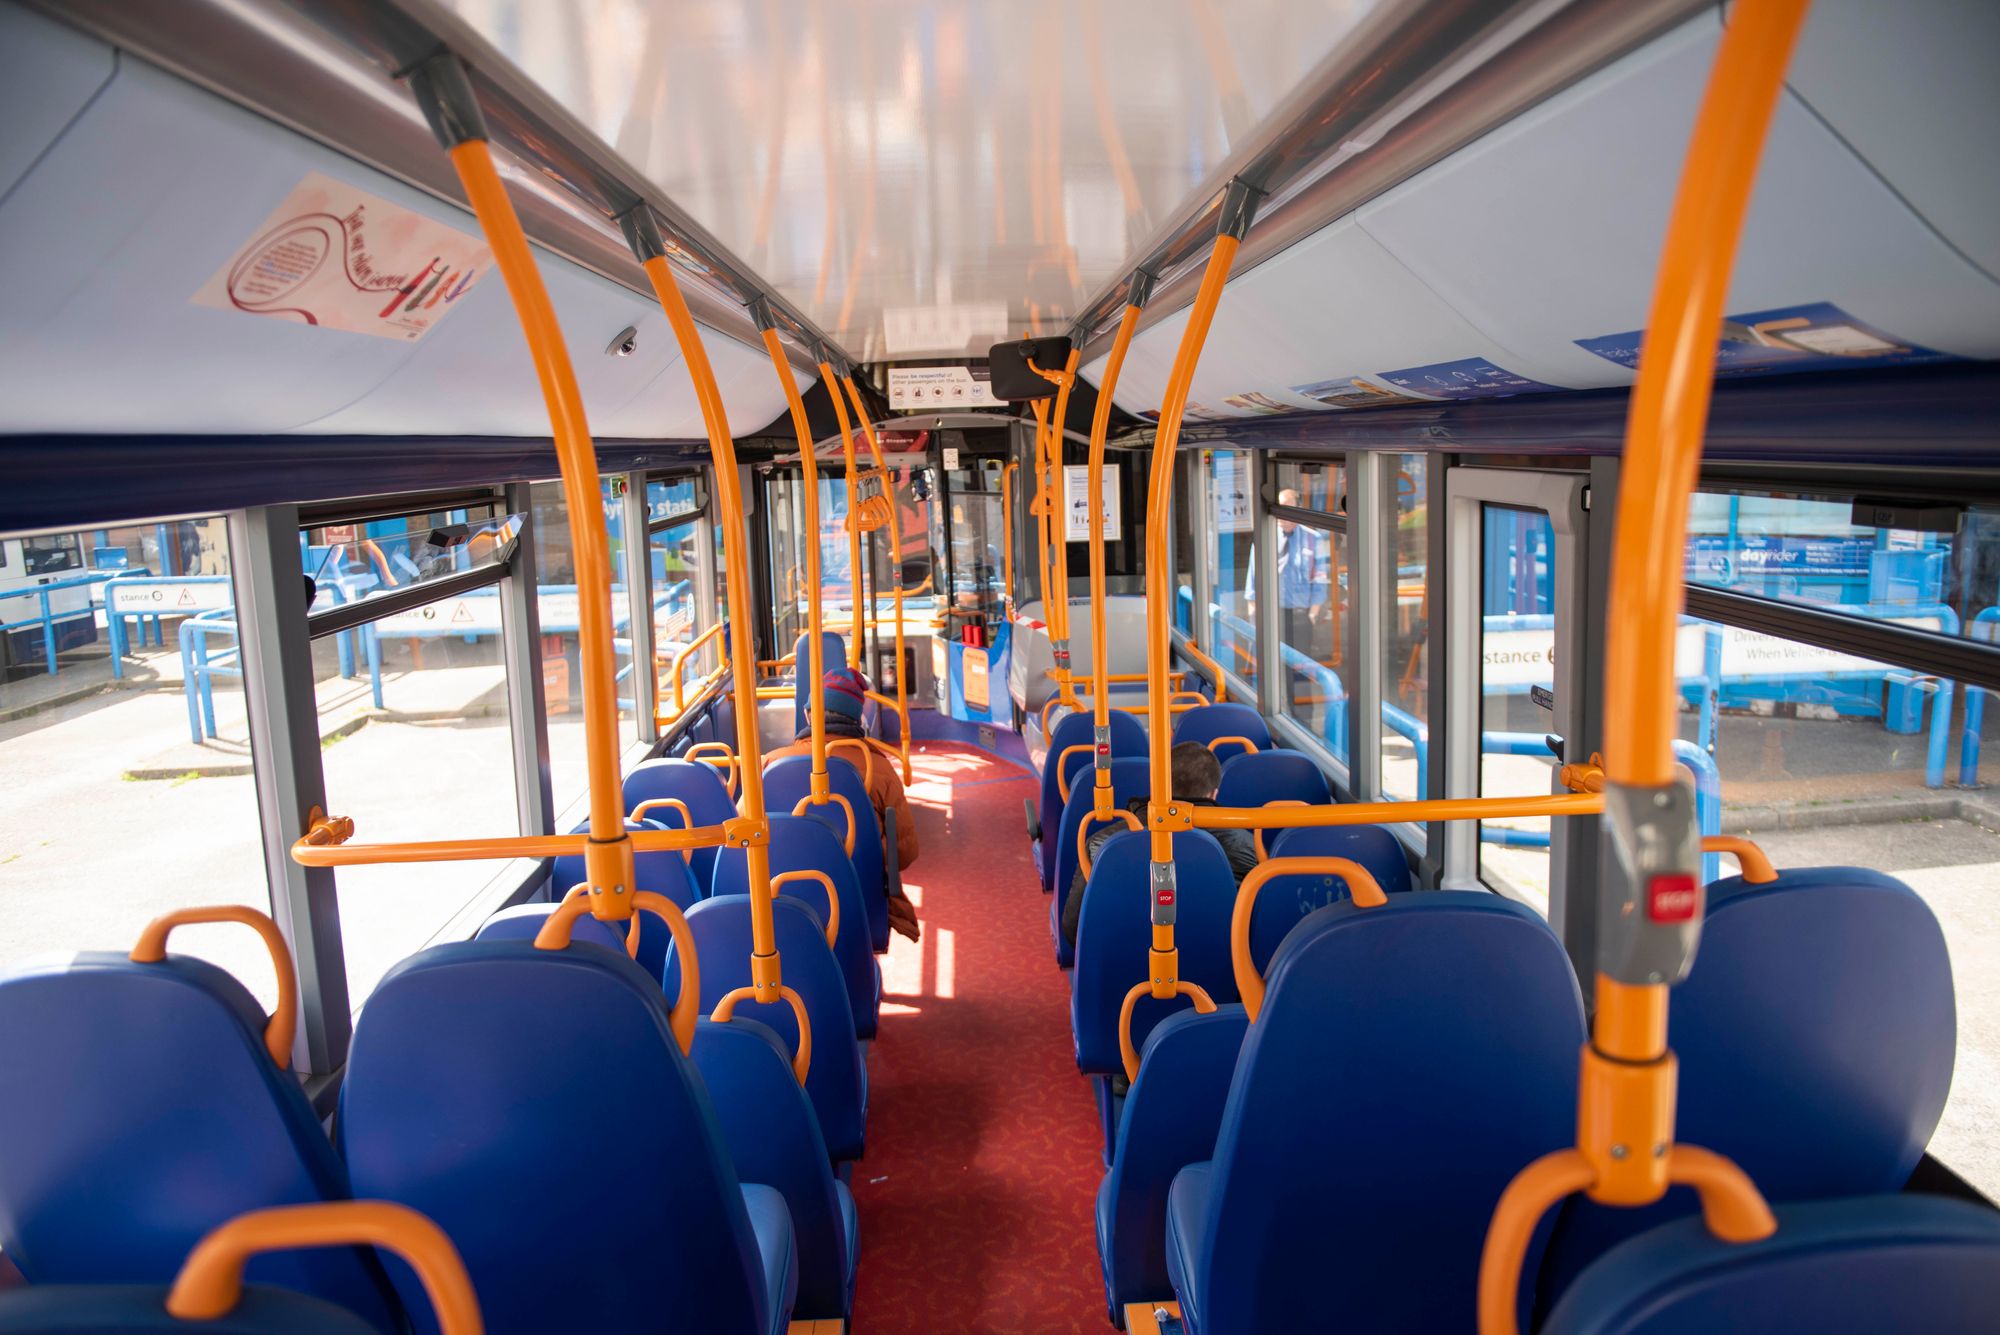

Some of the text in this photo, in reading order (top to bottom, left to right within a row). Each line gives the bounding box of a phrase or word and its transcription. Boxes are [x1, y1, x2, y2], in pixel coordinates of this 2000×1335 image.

[1739, 548, 1799, 565] dayrider
[120, 592, 149, 602] stance
[1484, 650, 1541, 664] stance
[1746, 648, 1781, 660] When
